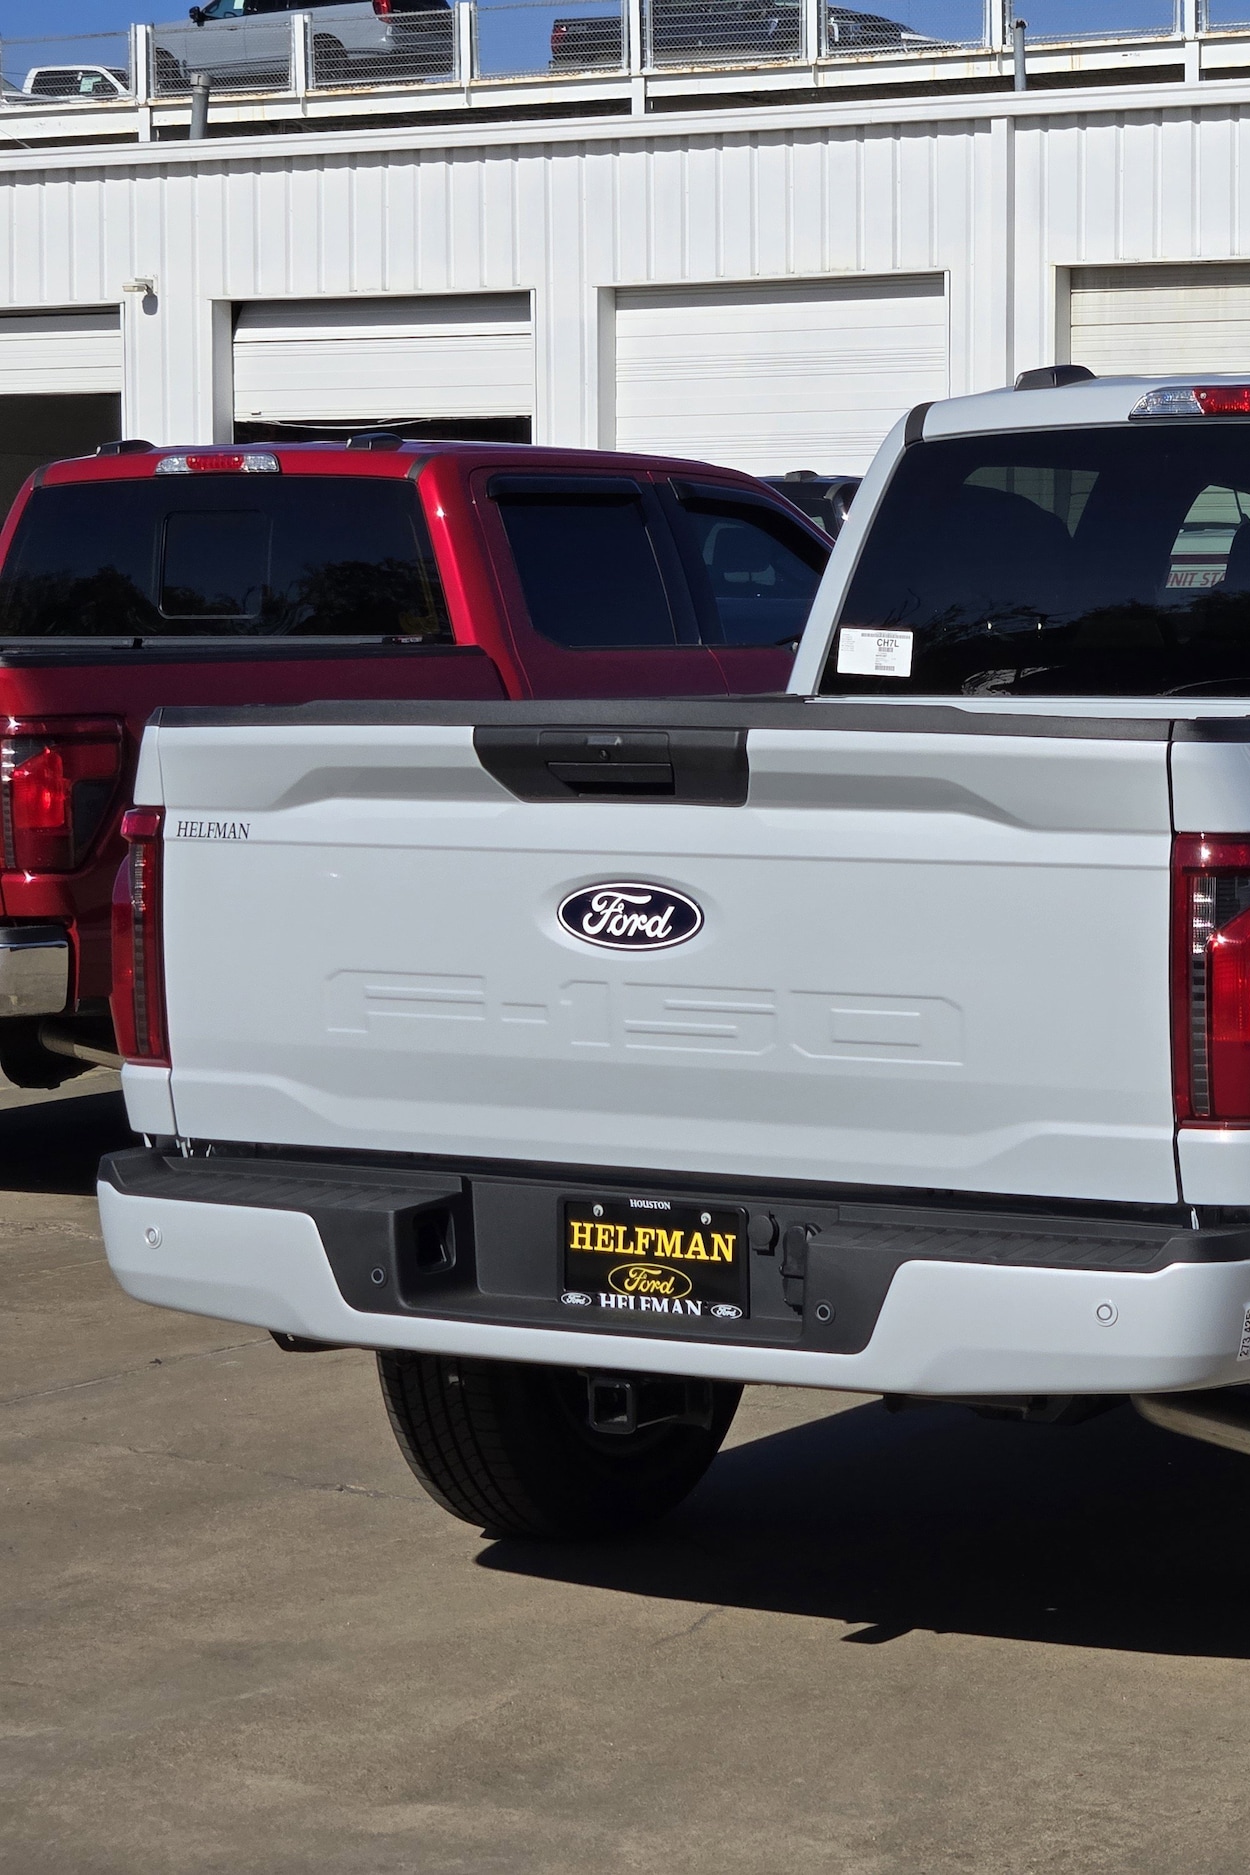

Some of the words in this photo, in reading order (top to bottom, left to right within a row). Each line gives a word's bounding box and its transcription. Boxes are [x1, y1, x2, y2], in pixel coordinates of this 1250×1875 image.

[876, 638, 899, 648] CH7L
[176, 820, 251, 839] HELFMAN
[582, 890, 674, 940] Ford
[326, 968, 963, 1066] F-150
[629, 1198, 671, 1211] HOUSTON
[570, 1221, 736, 1262] HELFMAN
[623, 1266, 675, 1294] Ford
[1239, 1336, 1250, 1357] 273
